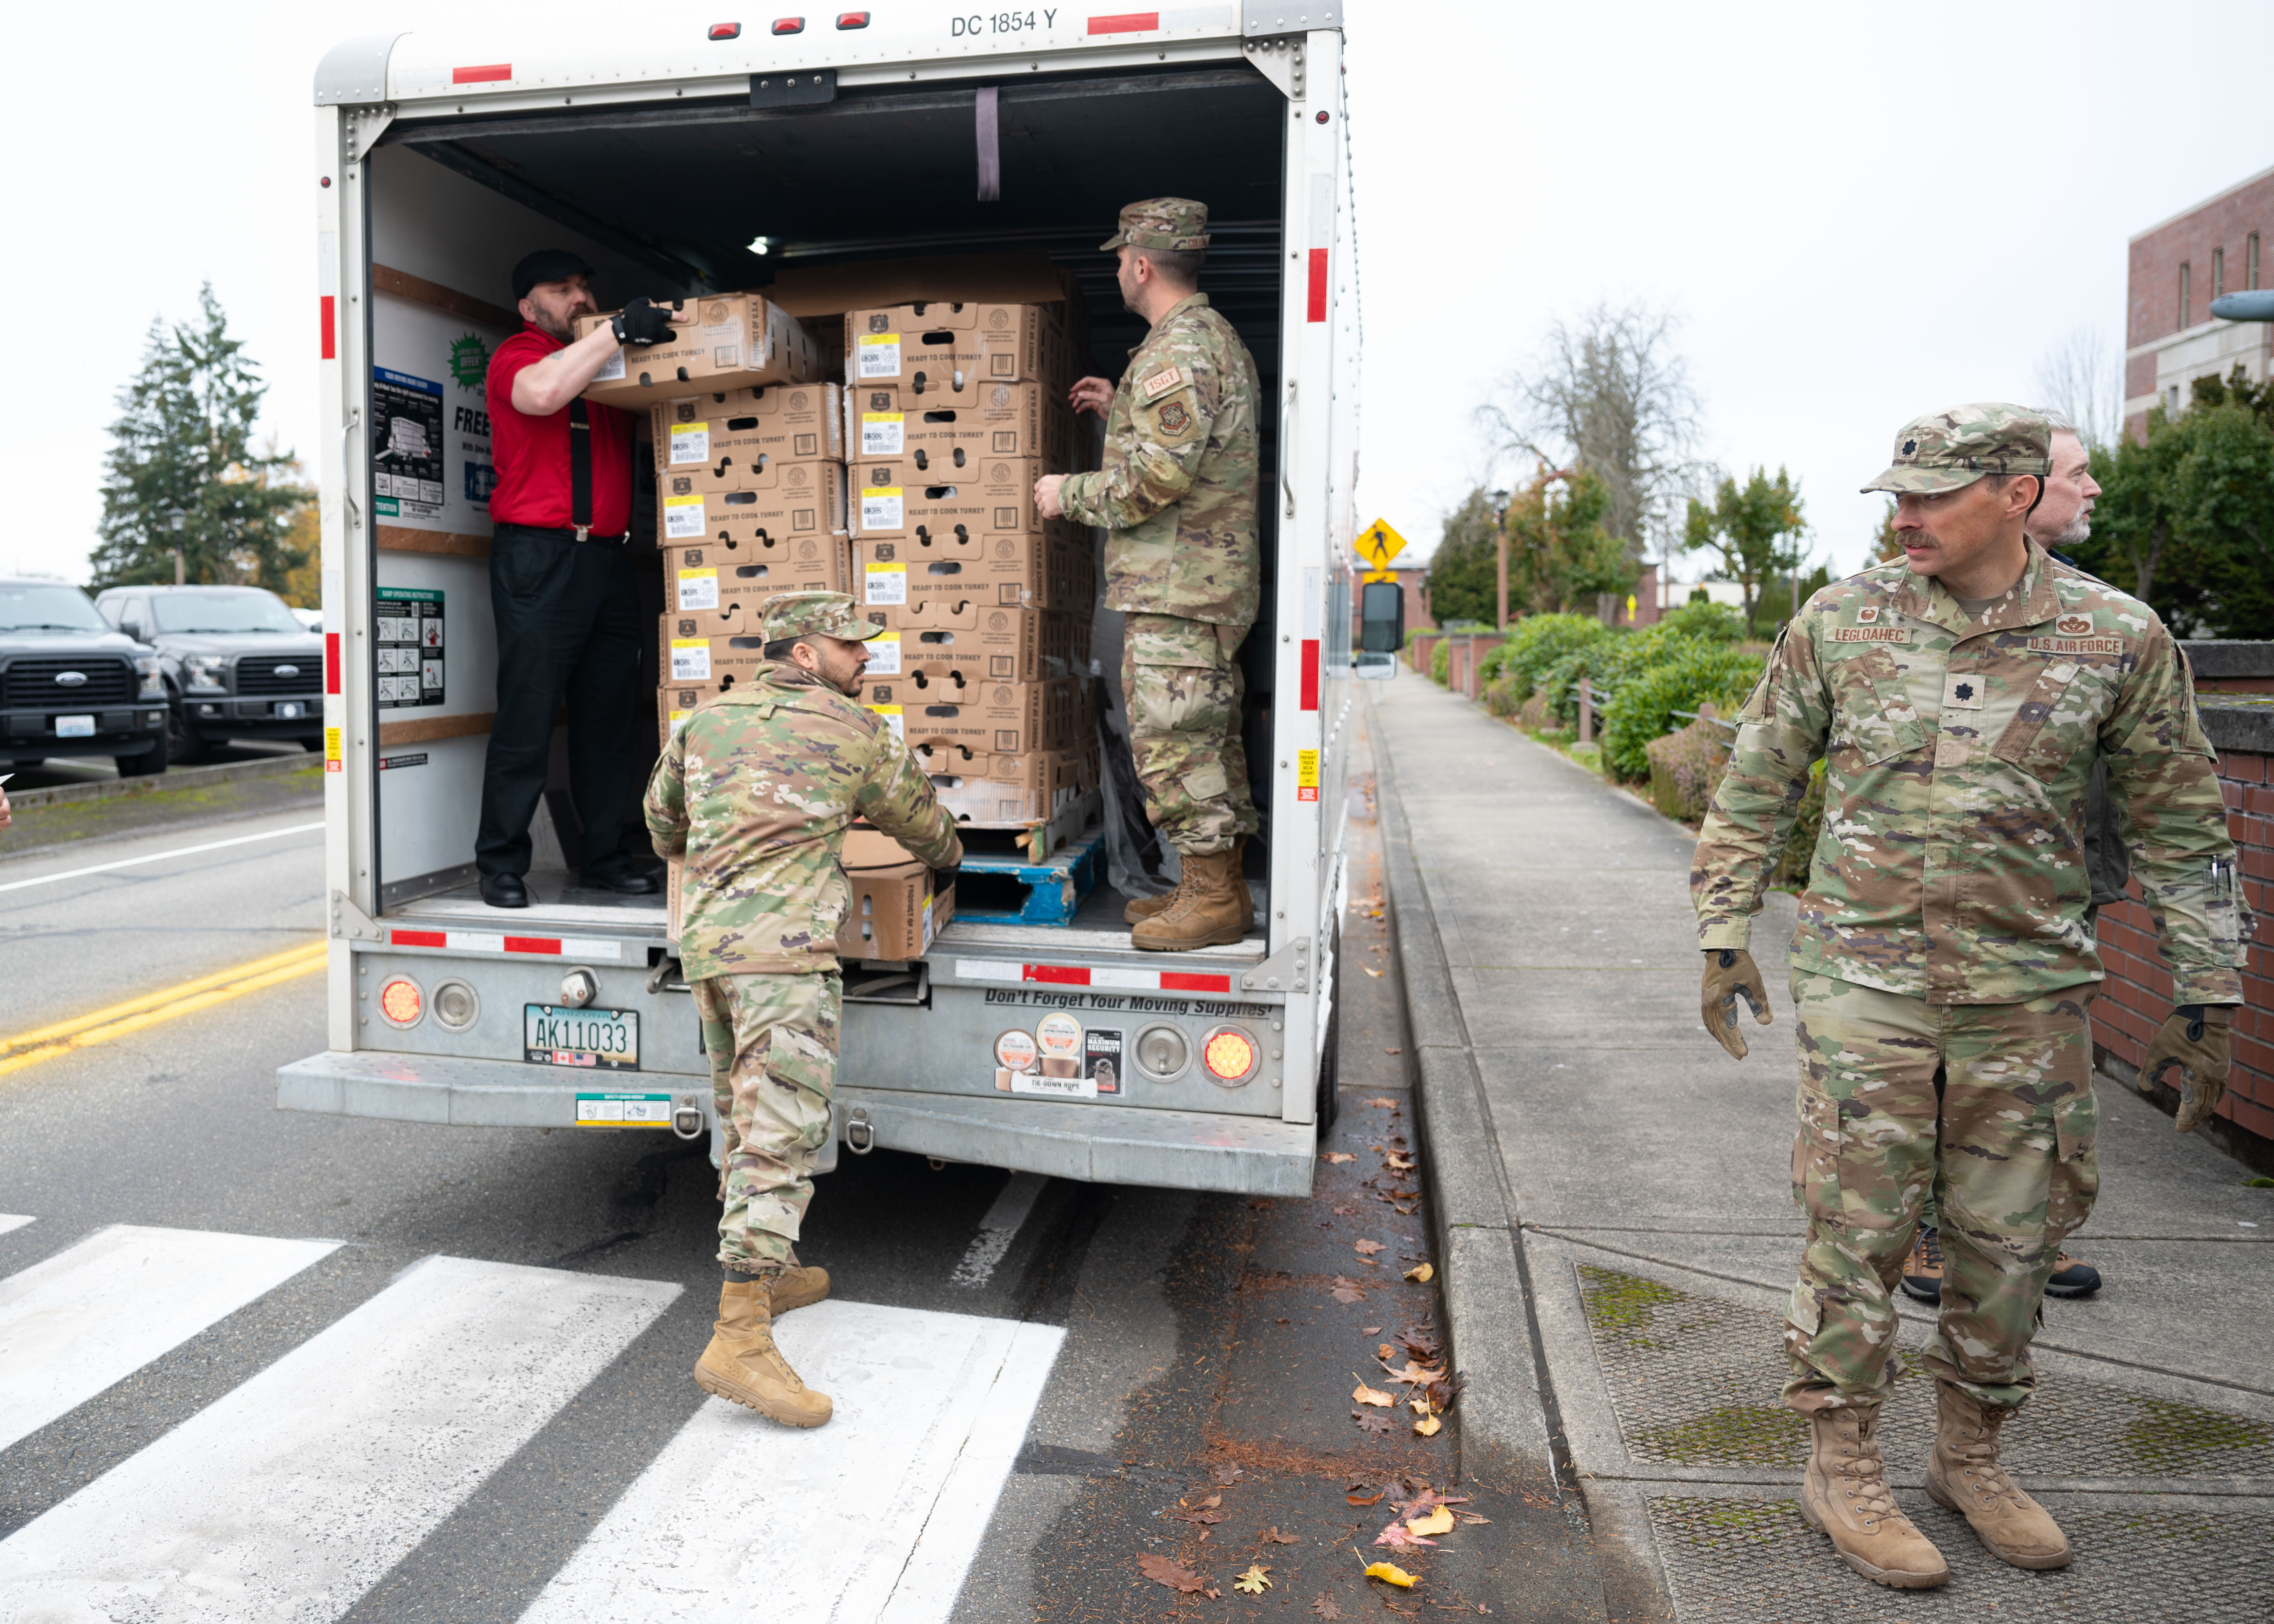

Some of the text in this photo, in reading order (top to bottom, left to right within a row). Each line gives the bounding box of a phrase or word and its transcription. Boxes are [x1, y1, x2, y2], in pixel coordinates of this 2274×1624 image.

[952, 8, 1057, 37] DC 1854 Y
[755, 319, 760, 329] OF
[1030, 332, 1035, 341] OF
[631, 355, 651, 364] READY
[1148, 371, 1175, 390] 1SGT
[1031, 408, 1037, 417] OF
[455, 406, 490, 438] FREE
[829, 485, 834, 495] OF
[376, 501, 397, 513] TTENTION
[839, 560, 845, 568] OF
[1037, 560, 1043, 569] OF
[1027, 633, 1033, 643] OF
[1835, 628, 1904, 642] LEGLOAHEC
[2031, 636, 2120, 653] U.S. AIR FORCE
[1032, 707, 1038, 716] OF
[1039, 778, 1044, 788] OF
[908, 918, 913, 928] OF
[985, 989, 1028, 1004] Don't
[1032, 990, 1085, 1009] Forget
[1090, 994, 1124, 1009] Your
[1129, 996, 1188, 1015] Moving
[554, 1010, 610, 1019] ARIZONA
[536, 1018, 626, 1053] AK11033
[1087, 1045, 1120, 1053] SECURITY
